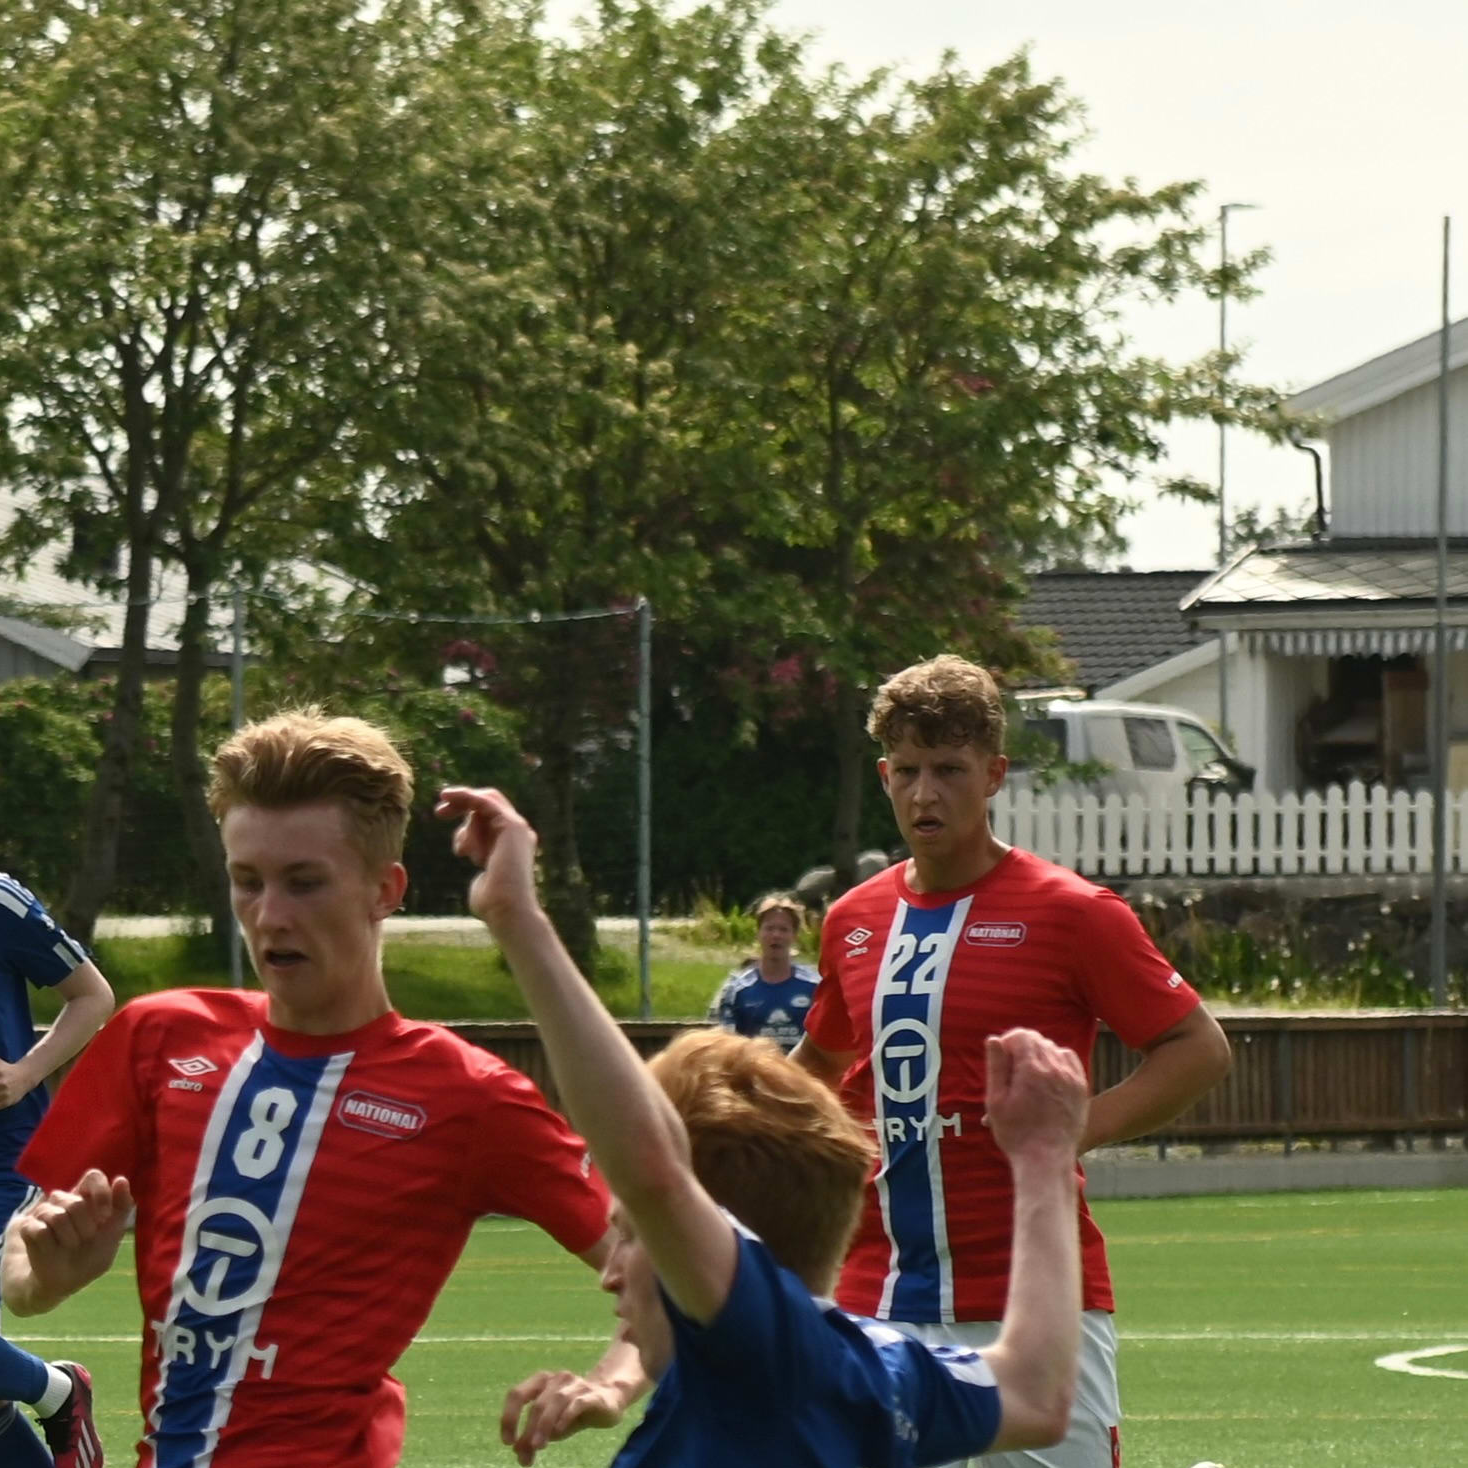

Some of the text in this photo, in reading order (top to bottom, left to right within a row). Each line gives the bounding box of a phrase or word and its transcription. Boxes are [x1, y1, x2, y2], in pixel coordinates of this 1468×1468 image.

[880, 932, 950, 995] 22
[232, 1086, 298, 1180] 8
[344, 1098, 419, 1130] NATIONAL
[150, 1320, 279, 1380] TRYM
